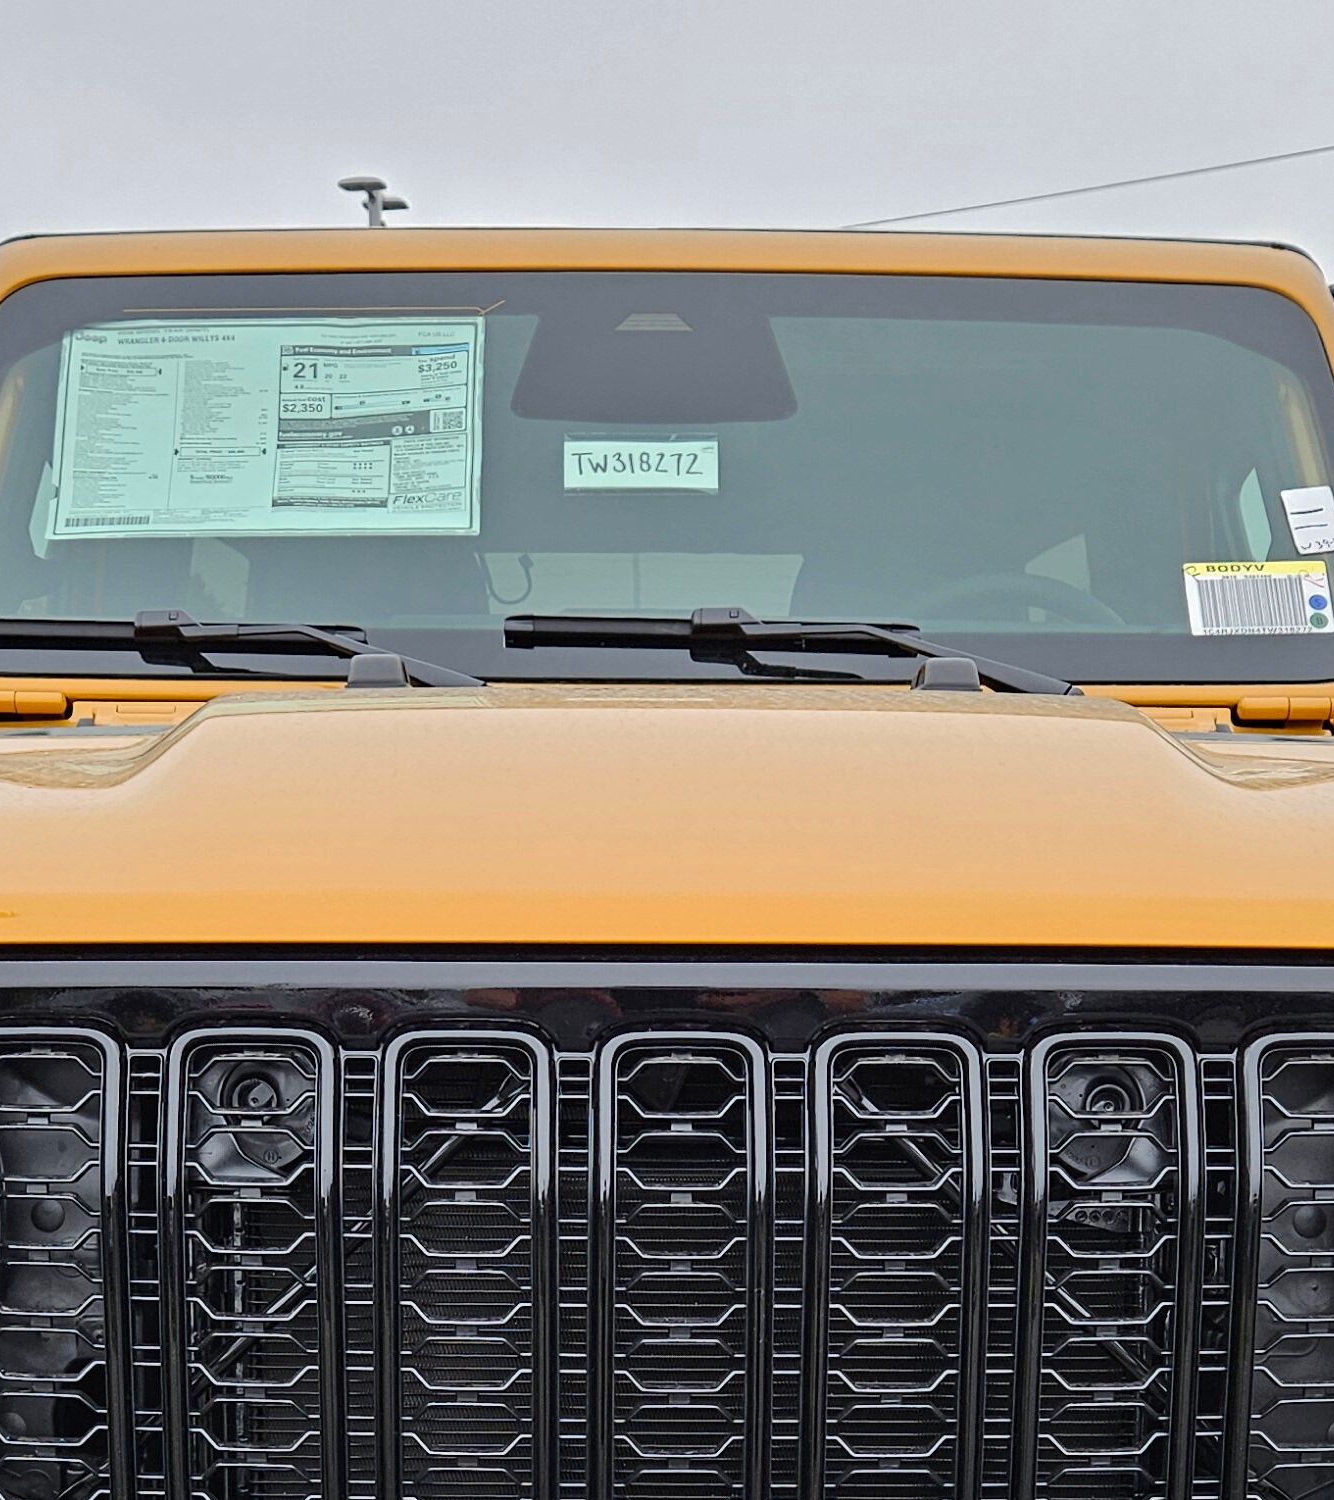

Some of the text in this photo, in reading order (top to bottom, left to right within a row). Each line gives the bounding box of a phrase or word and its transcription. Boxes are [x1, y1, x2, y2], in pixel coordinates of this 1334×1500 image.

[293, 362, 319, 379] 21
[418, 360, 458, 374] $3,250
[282, 403, 324, 414] $2,350
[571, 452, 703, 476] TW318272
[392, 491, 462, 505] FlexCare
[1205, 564, 1265, 573] BODYV
